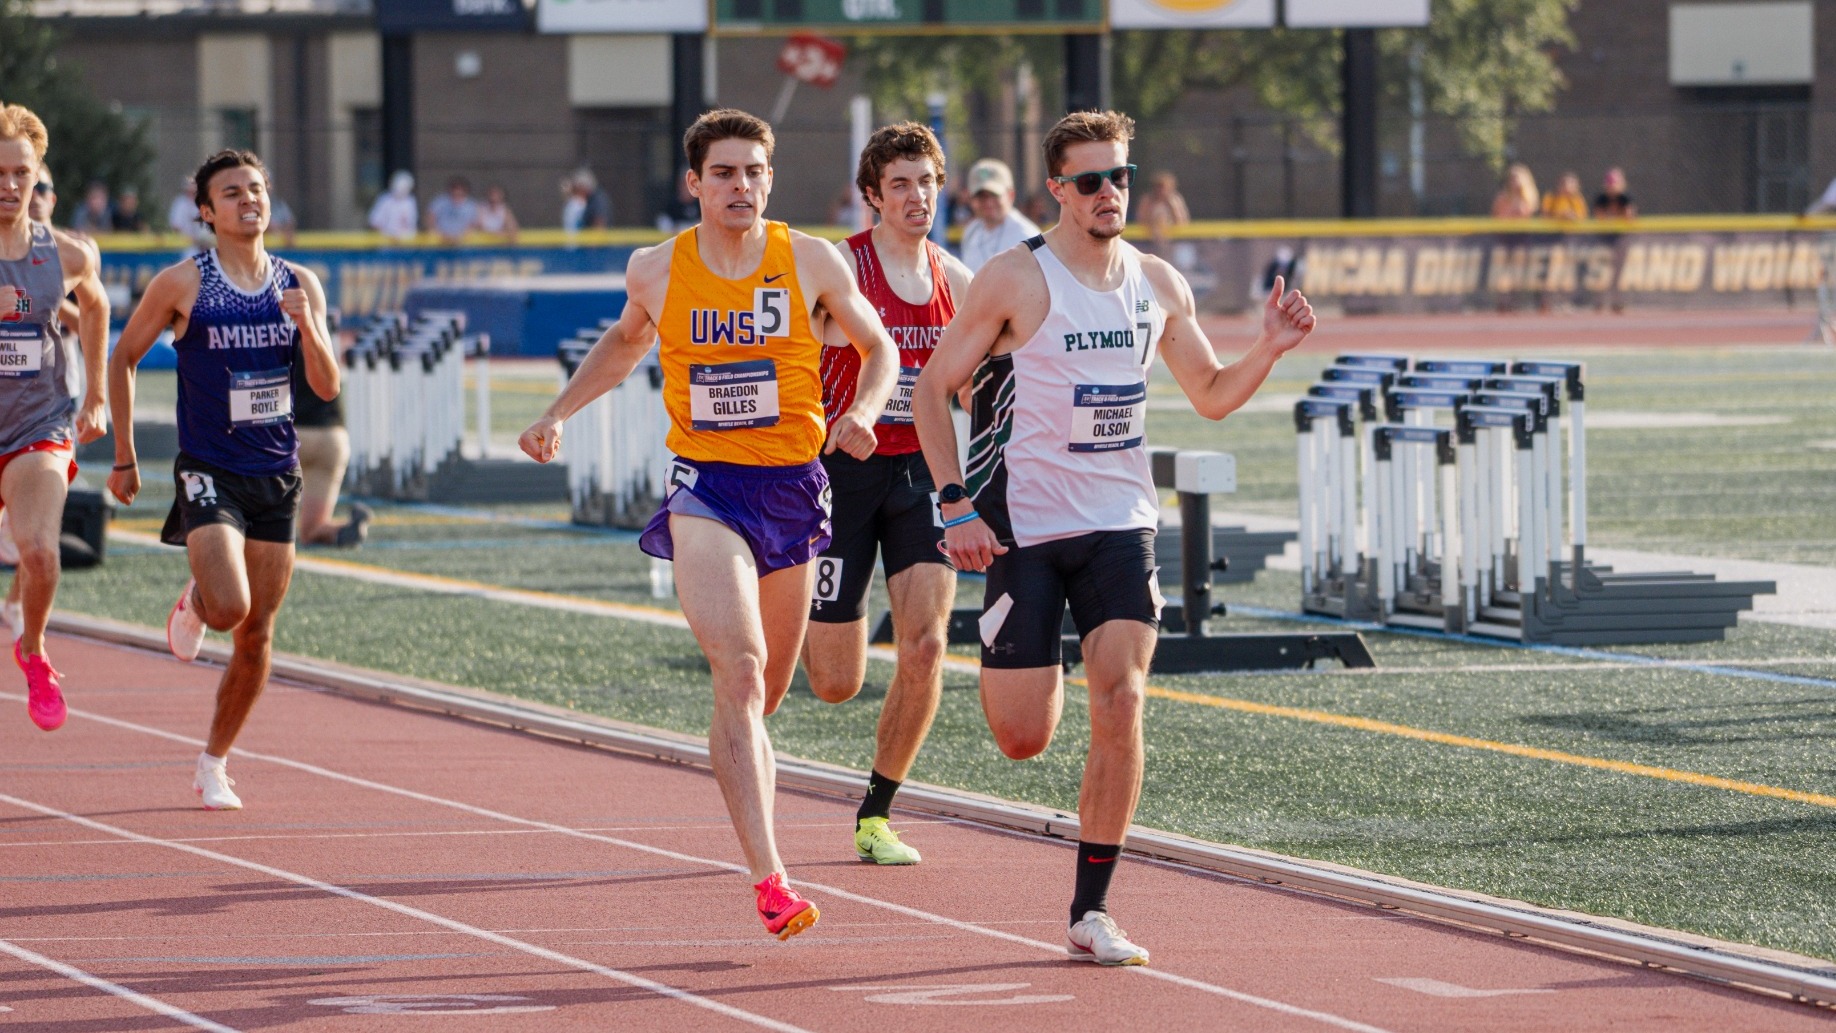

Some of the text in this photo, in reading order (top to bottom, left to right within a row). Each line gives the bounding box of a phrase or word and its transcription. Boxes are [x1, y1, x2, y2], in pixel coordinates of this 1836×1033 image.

[1617, 242, 1706, 292] AND
[761, 291, 781, 333] 5
[207, 322, 298, 350] AMHERST
[885, 326, 947, 350] CKINS
[1063, 329, 1134, 352] PLYMOU
[1136, 322, 1151, 365] 7
[250, 388, 280, 401] PARKER
[709, 385, 758, 398] BRAEDON
[251, 400, 279, 415] BOYLE
[713, 400, 756, 415] GILLES
[885, 398, 913, 412] RICH
[1093, 407, 1133, 420] MICHAEL
[1093, 421, 1130, 437] OLSON
[816, 559, 835, 598] 8
